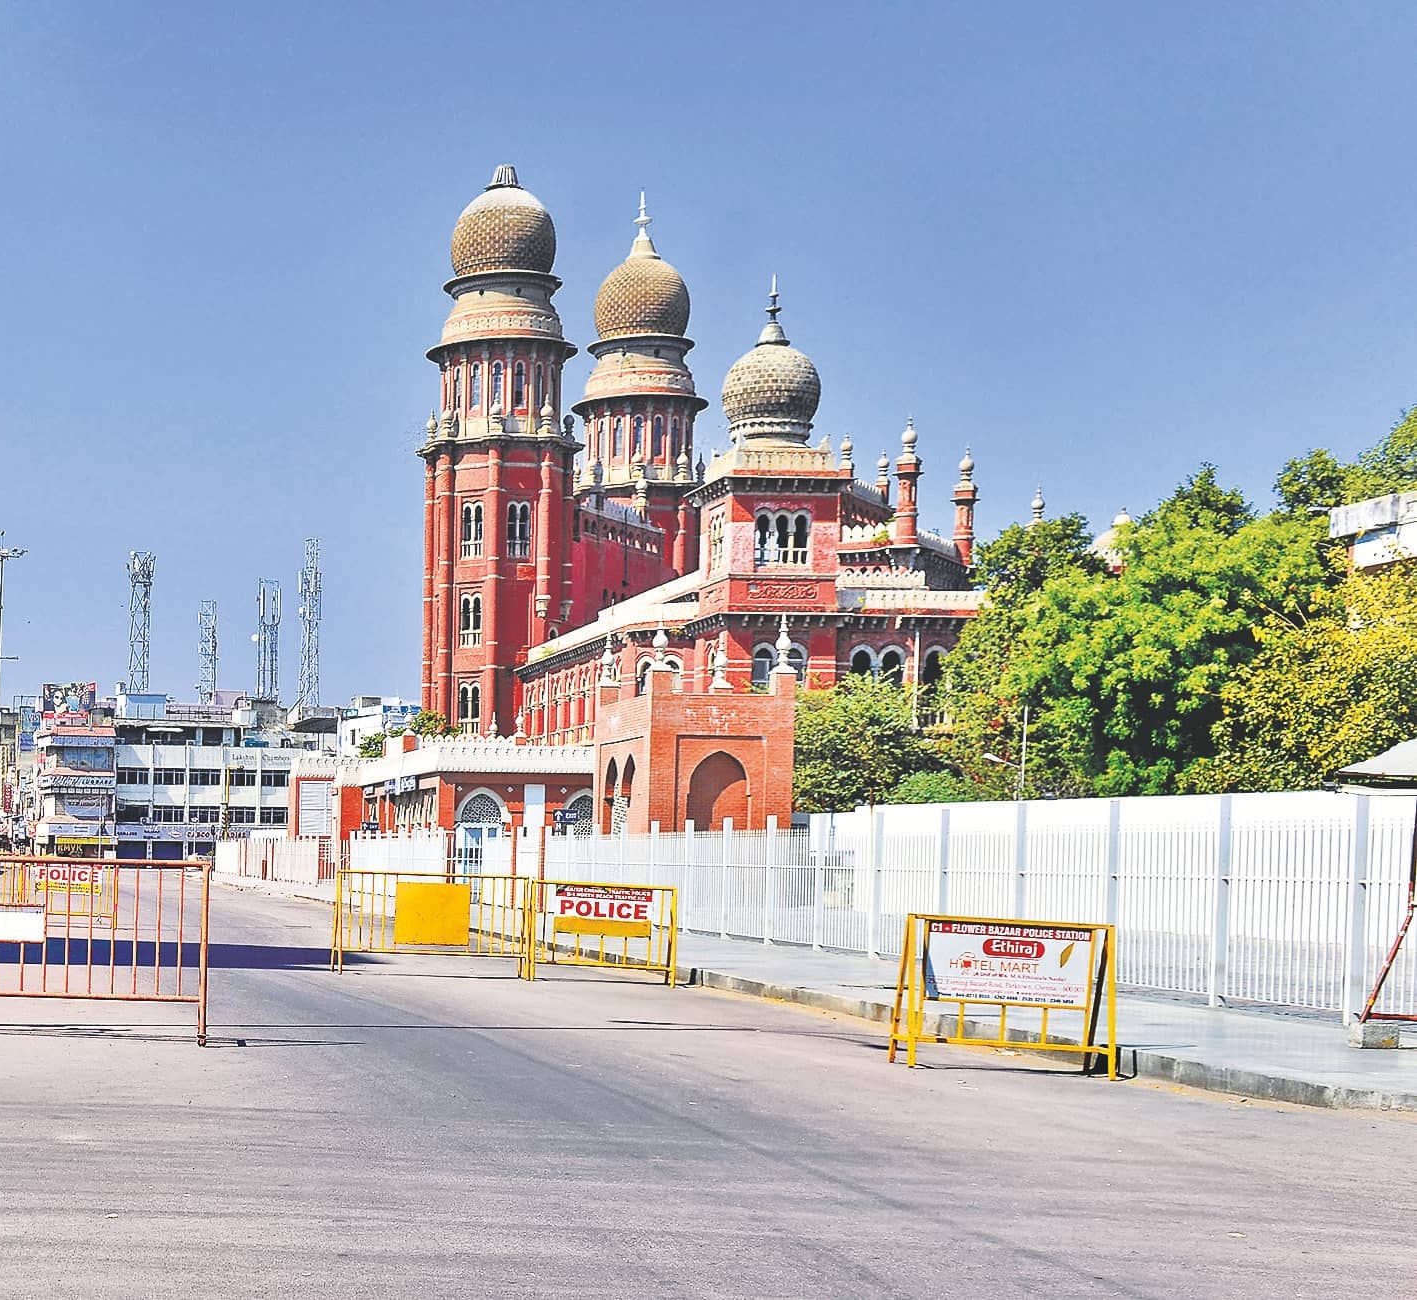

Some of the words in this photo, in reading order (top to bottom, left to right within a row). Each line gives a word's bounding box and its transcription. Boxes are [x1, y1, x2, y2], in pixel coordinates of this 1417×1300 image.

[560, 899, 648, 920] POLICE
[932, 922, 943, 932] C1
[951, 923, 987, 935] FLOWER
[988, 925, 1021, 937] BAZAAR
[1023, 928, 1054, 939] POLICE
[1055, 930, 1091, 941] STATION
[990, 940, 1039, 958] Ethiraj
[1000, 961, 1040, 974] MART
